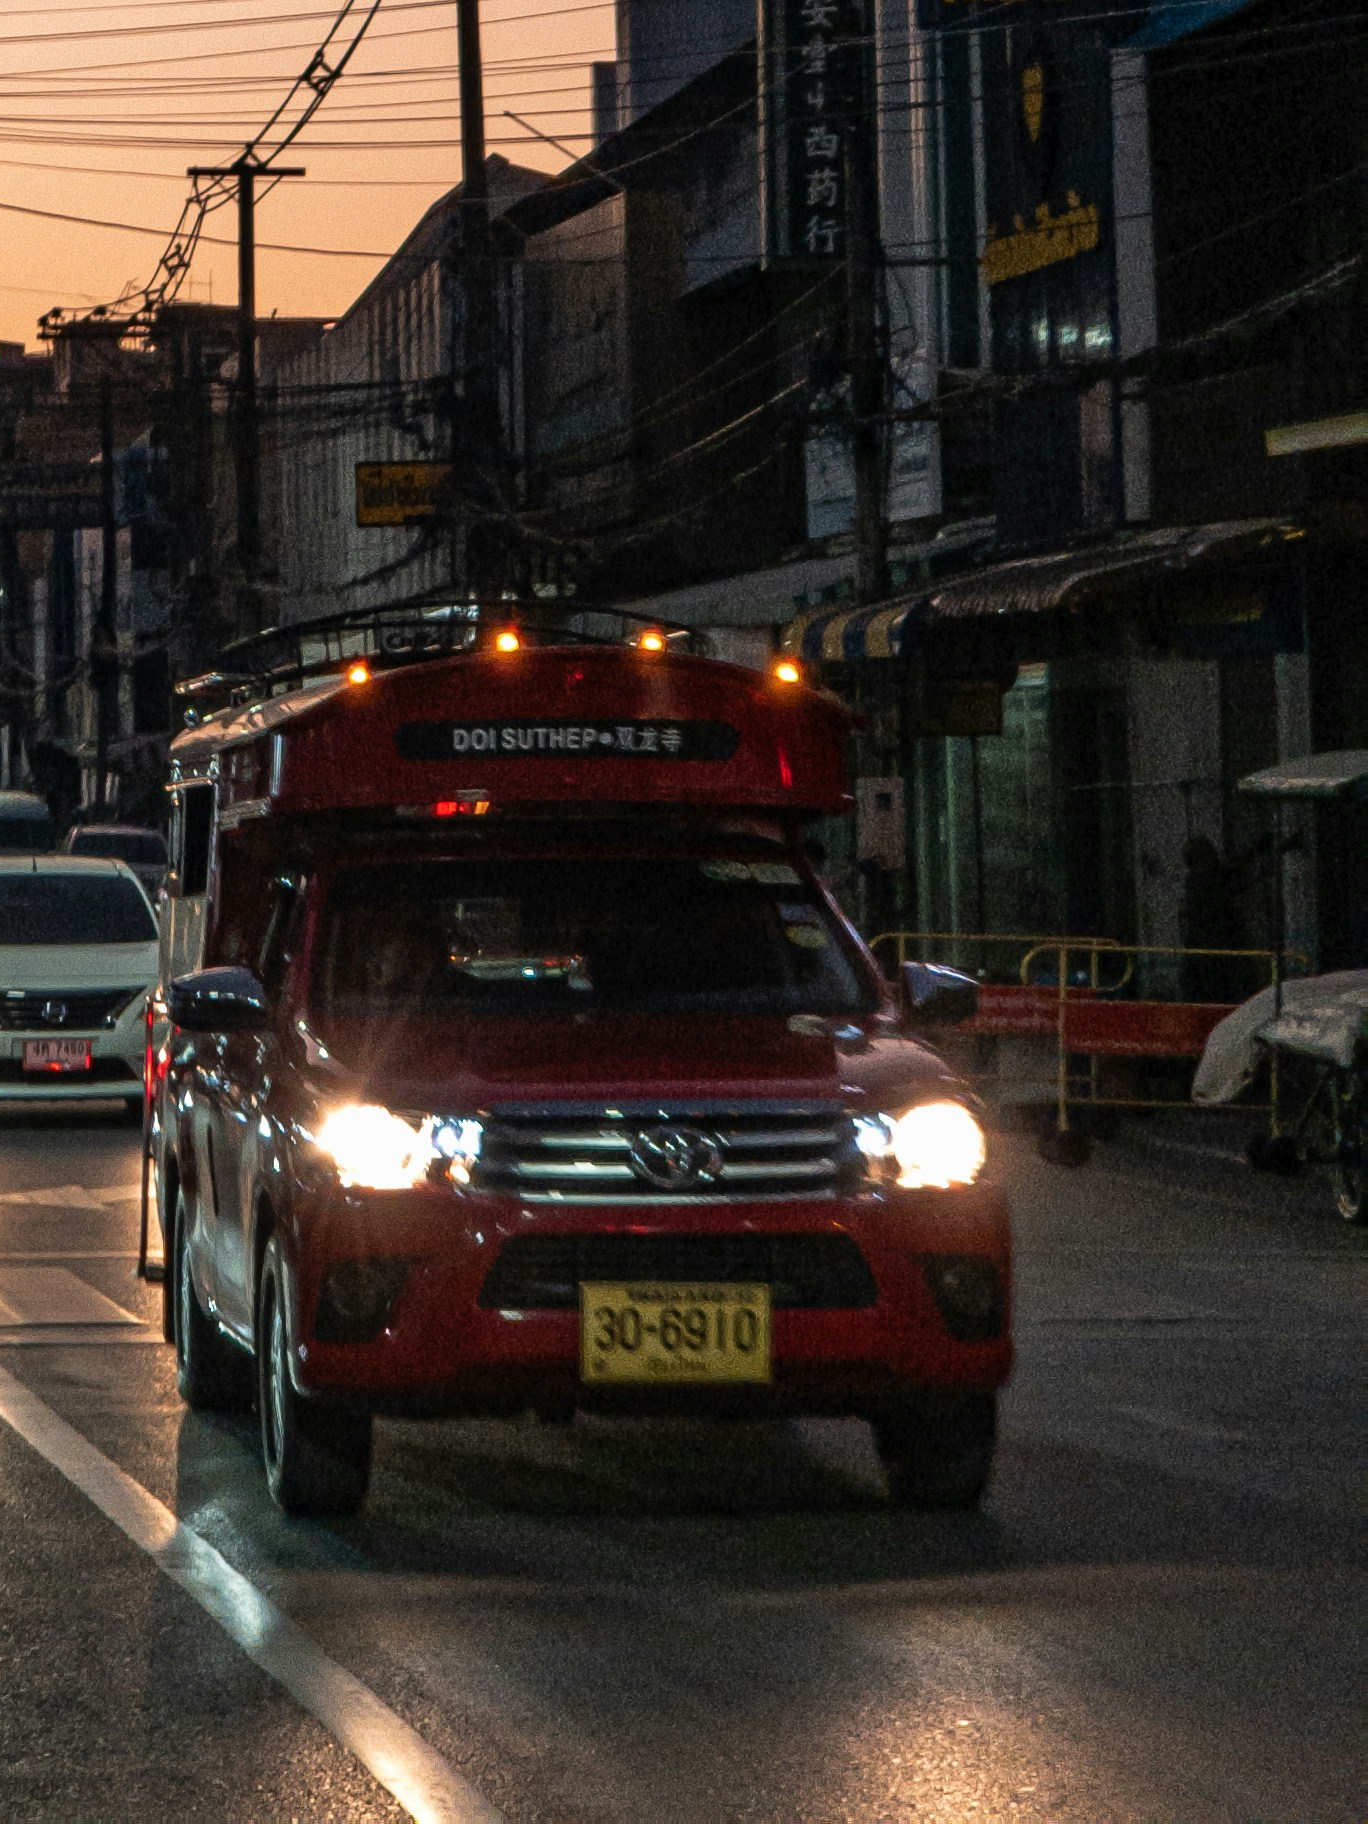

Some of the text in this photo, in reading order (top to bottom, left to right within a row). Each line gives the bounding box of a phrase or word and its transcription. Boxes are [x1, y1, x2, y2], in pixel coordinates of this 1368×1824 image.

[452, 727, 596, 752] DOI SUTHEP
[594, 1307, 757, 1354] 30-6910
